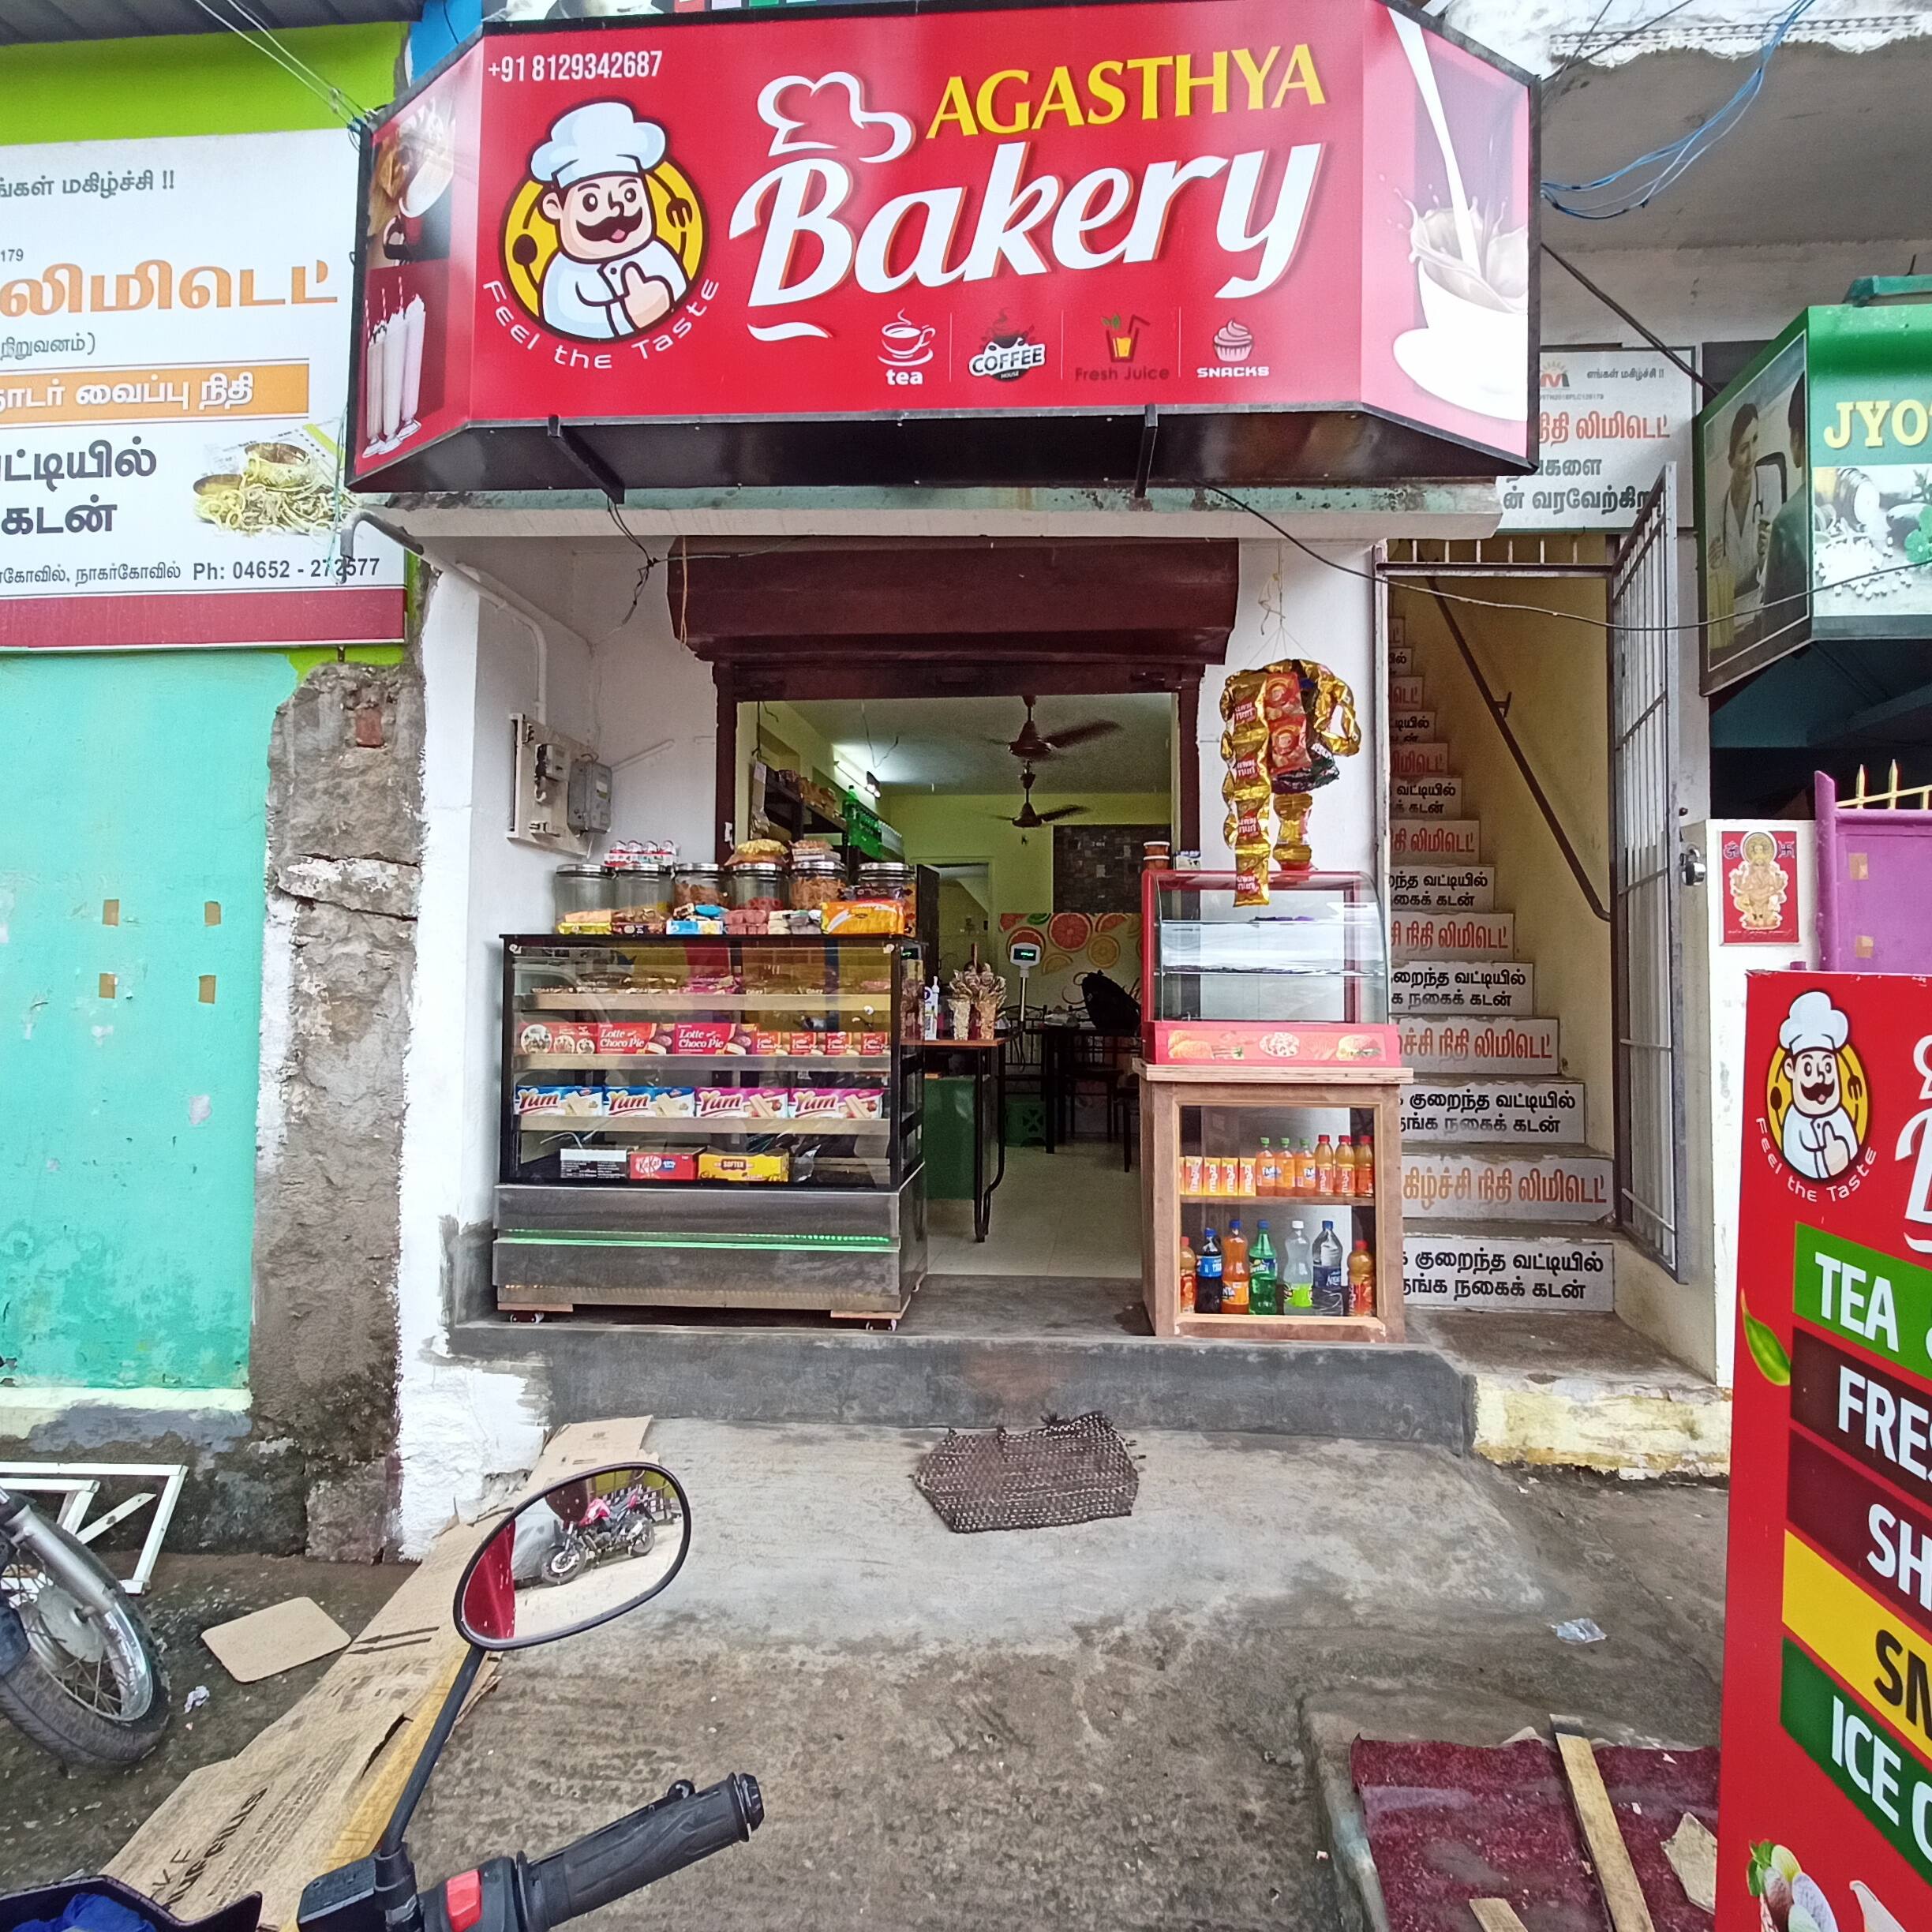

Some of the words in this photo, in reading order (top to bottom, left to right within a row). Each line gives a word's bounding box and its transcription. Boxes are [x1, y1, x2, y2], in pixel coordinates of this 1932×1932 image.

[489, 55, 526, 82] +91
[531, 51, 663, 80] 8129342687
[926, 43, 1327, 140] AGASTHYA
[62, 170, 154, 199] மகிழ்ச்சி
[729, 140, 1326, 308] Bakery
[0, 259, 338, 317] லிமிடெட்
[553, 344, 612, 369] the
[631, 279, 720, 361] Taste
[972, 346, 1044, 375] COFFEE
[1075, 366, 1118, 382] Fresh
[1124, 365, 1170, 381] Juice
[1196, 366, 1270, 378] SNACKS
[886, 368, 923, 385] tea
[76, 374, 189, 410] வைப்பு
[199, 371, 254, 411] நிதி
[1575, 410, 1671, 440] லிமிடெட்
[1823, 399, 1932, 449] JYO
[1, 494, 118, 535] கடன்
[75, 560, 181, 587] நாகர்கோவில்
[193, 562, 224, 580] Ph:
[233, 560, 290, 579] 04652
[1410, 827, 1475, 853] லிமிடெட்
[1423, 871, 1488, 890] வட்டியில்
[1436, 891, 1476, 907] கடன்
[1438, 920, 1509, 949] லிமிடெட்
[1455, 968, 1526, 989] வட்டியில்
[1409, 988, 1465, 1010] நகைக்
[1470, 990, 1512, 1007] கடன்
[600, 1038, 627, 1048] Choco
[601, 1028, 625, 1038] Lotte
[678, 1038, 706, 1048] Choco
[680, 1028, 702, 1038] Lotte
[1474, 1028, 1553, 1059] லிமிடெட்
[519, 1090, 560, 1110] Yum
[608, 1091, 650, 1111] Yum
[700, 1091, 742, 1112] Yum
[795, 1091, 837, 1112] Yum
[1410, 1088, 1490, 1114] குறைந்த
[1496, 1089, 1576, 1114] வட்டியில்
[1513, 1114, 1561, 1134] கடன்
[1518, 1167, 1608, 1204] லிமிடெட்
[1787, 1174, 1818, 1203] the
[1825, 1146, 1877, 1202] Taste
[1415, 1246, 1507, 1275] குறைந்த
[1512, 1250, 1604, 1277] வட்டியில்
[1454, 1275, 1526, 1301] நகைக்
[1532, 1279, 1586, 1300] கடன்
[1814, 1251, 1900, 1353] TEA
[1838, 1365, 1932, 1483] FRE
[1831, 1695, 1901, 1827] ICE
